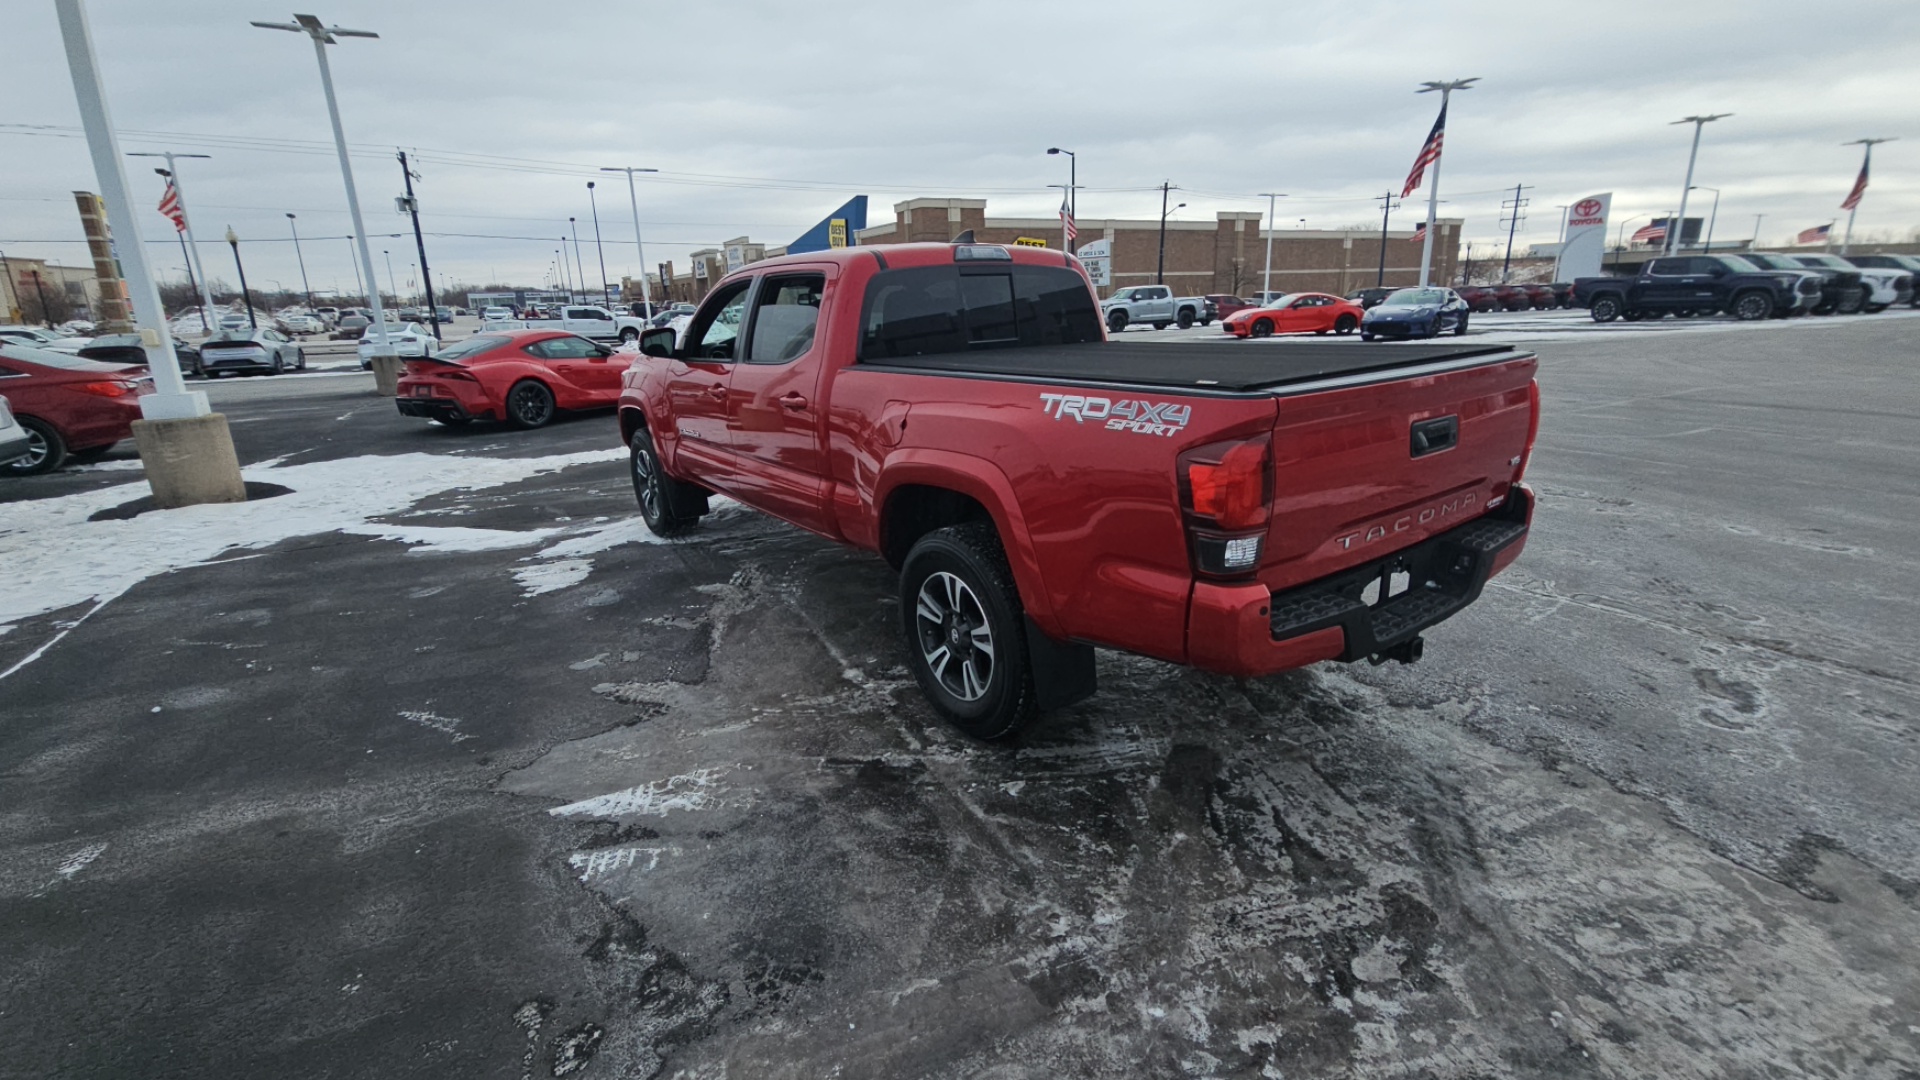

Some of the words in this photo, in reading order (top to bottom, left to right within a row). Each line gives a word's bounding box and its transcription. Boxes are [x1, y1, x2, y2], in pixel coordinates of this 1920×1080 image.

[1569, 217, 1604, 226] TOYOTA
[831, 224, 845, 235] BEST
[831, 236, 845, 248] BUY
[1016, 240, 1045, 248] BEST
[1104, 418, 1184, 437] SPORT
[1335, 492, 1478, 549] TACOMA
